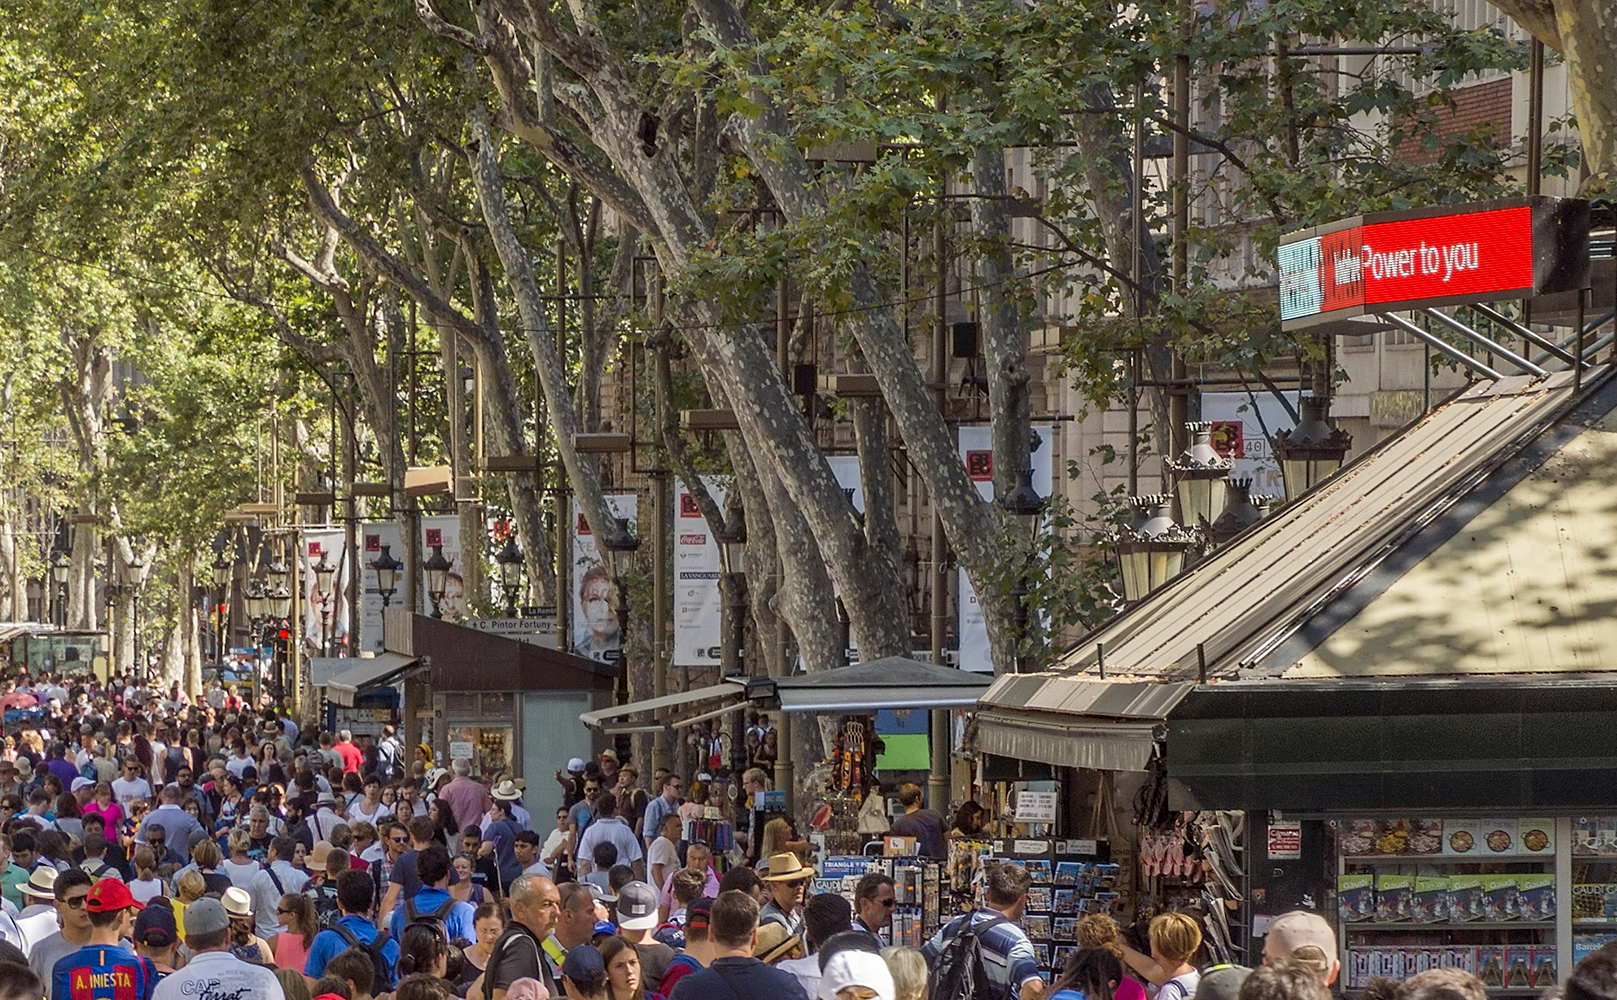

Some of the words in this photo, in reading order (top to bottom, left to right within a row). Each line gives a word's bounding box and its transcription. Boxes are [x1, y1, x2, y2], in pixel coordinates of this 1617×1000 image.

[1362, 245, 1417, 281] Power
[1421, 241, 1440, 275] to
[1442, 242, 1479, 282] you
[1246, 441, 1262, 453] 40
[492, 621, 516, 629] Pintor
[520, 621, 552, 630] Fortuny
[76, 974, 88, 990] A.
[90, 973, 131, 988] INIESTA
[181, 978, 220, 996] CAP
